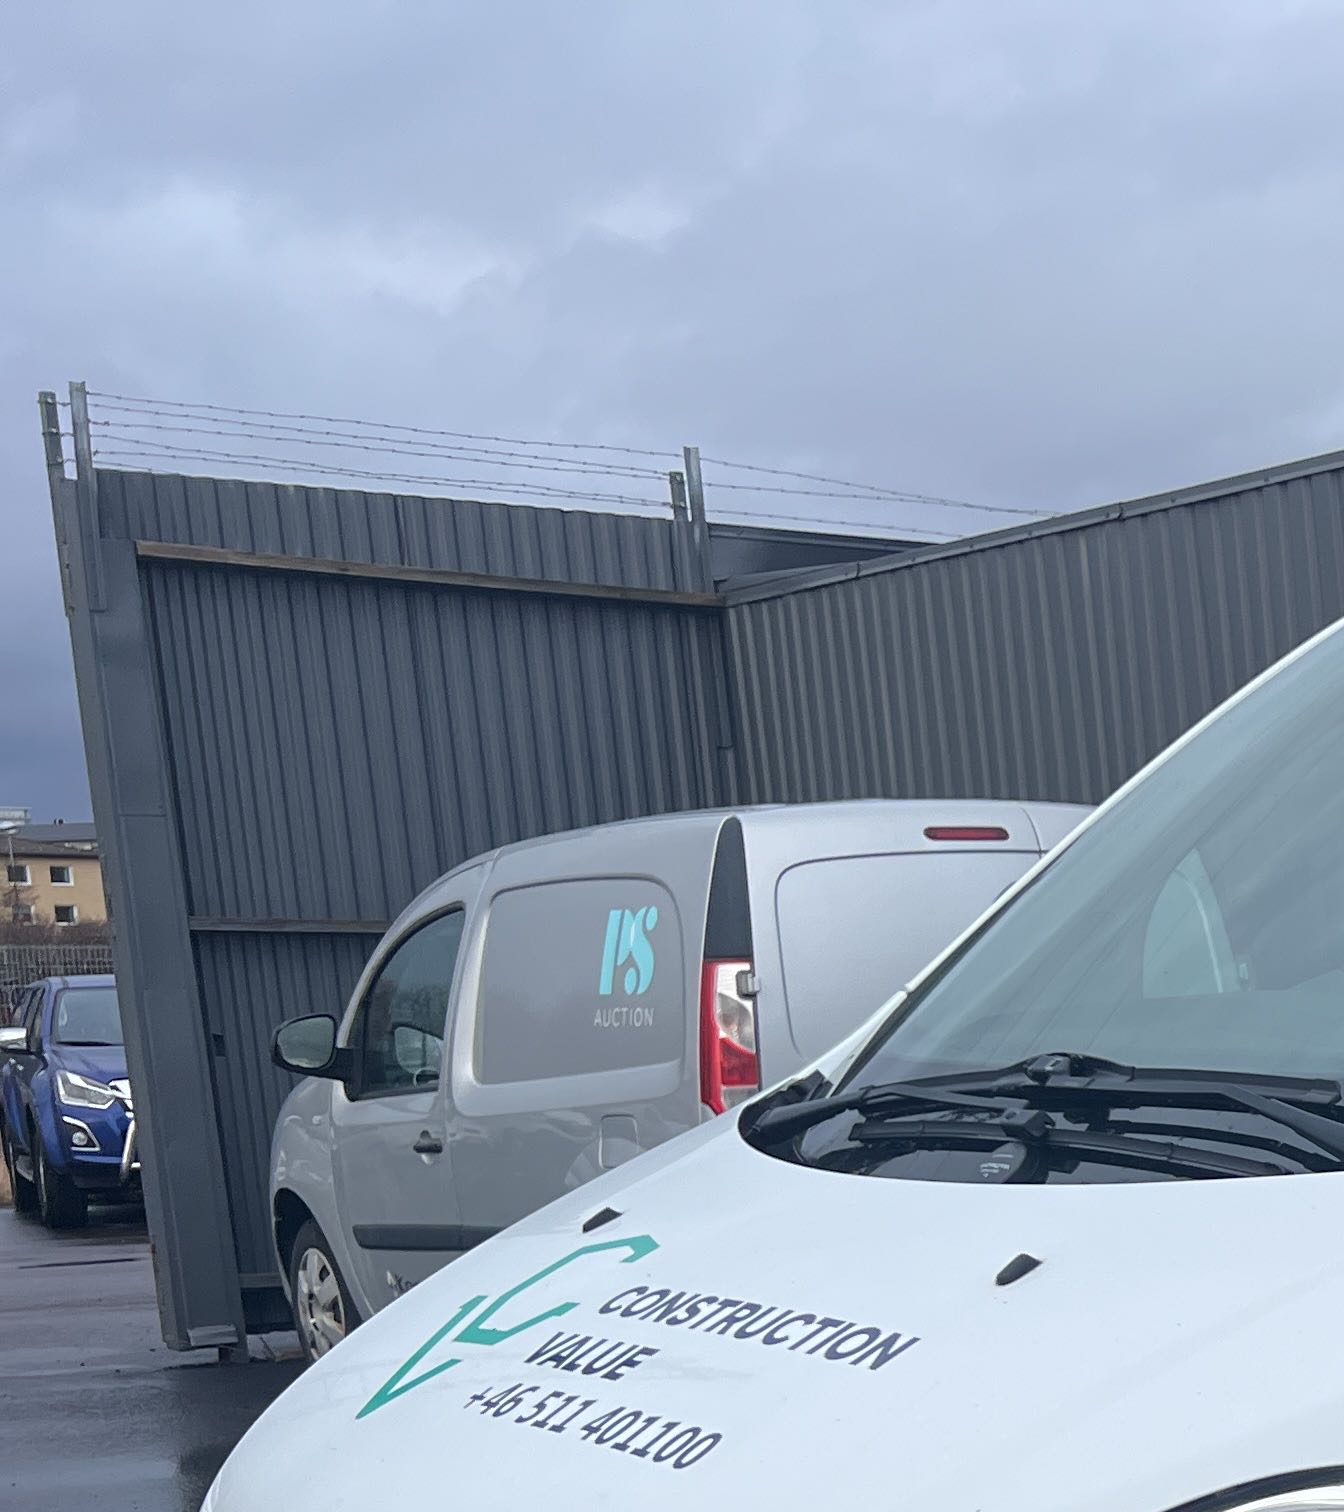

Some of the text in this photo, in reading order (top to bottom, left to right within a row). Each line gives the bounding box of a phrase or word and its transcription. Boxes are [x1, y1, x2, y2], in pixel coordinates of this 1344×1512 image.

[598, 905, 659, 995] PS
[593, 1006, 654, 1028] AUCTION
[524, 1332, 660, 1382] VALUE
[598, 1285, 920, 1371] CONSTRUCTION
[463, 1383, 724, 1470] +46 511 401100
